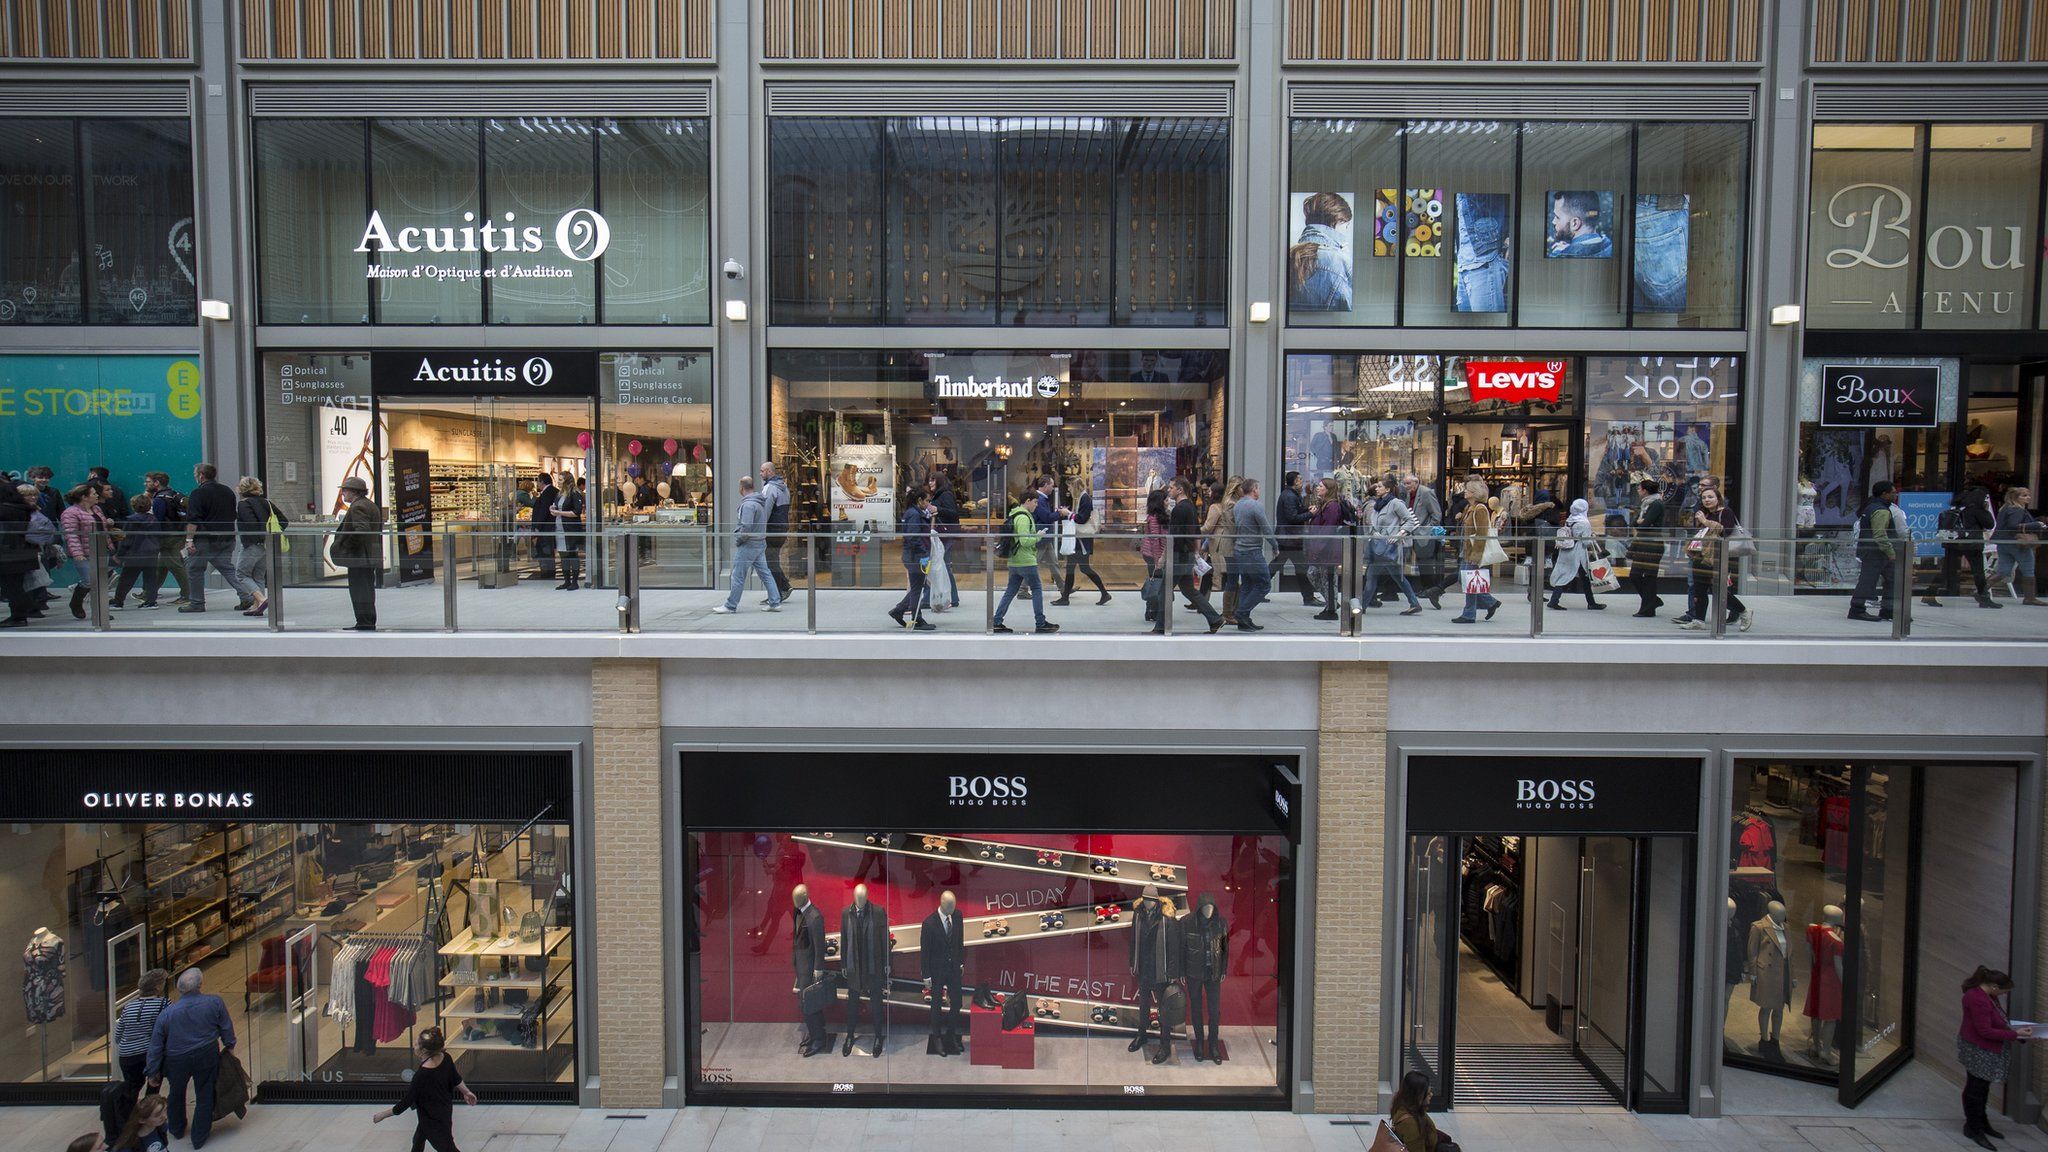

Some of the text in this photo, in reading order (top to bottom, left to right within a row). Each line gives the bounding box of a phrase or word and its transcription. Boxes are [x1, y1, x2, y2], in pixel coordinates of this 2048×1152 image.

[23, 174, 43, 186] ON
[45, 174, 73, 186] OUR
[93, 174, 138, 187] TWORK
[353, 209, 544, 253] Acuitis
[1826, 182, 2048, 270] Bou
[366, 265, 573, 282] Maison d'Optique et d'Audition
[1880, 291, 2015, 314] AENU
[294, 367, 327, 376] Optical
[413, 357, 517, 381] Acuitis
[632, 367, 665, 376] Optical
[294, 380, 345, 390] Sunglasses
[632, 381, 683, 390] Sunglasses
[934, 374, 1034, 398] Timberland
[1836, 374, 1925, 410] Boux
[24, 388, 133, 417] STORE
[295, 395, 331, 404] Hearing
[632, 395, 693, 404] Hearing Care
[1853, 409, 1906, 418] AVENUE
[835, 529, 872, 543] LET'S
[948, 776, 1028, 798] BOSS
[1516, 779, 1596, 802] BOSS
[84, 792, 255, 808] OLIVER BONAS
[1275, 789, 1289, 814] BOSS
[1516, 802, 1594, 810] HUGO BOSS
[985, 886, 1068, 911] HOLIDAY
[999, 969, 1017, 988] IN
[1023, 972, 1062, 993] THE
[1067, 978, 1116, 999] FAST
[322, 1070, 345, 1083] US
